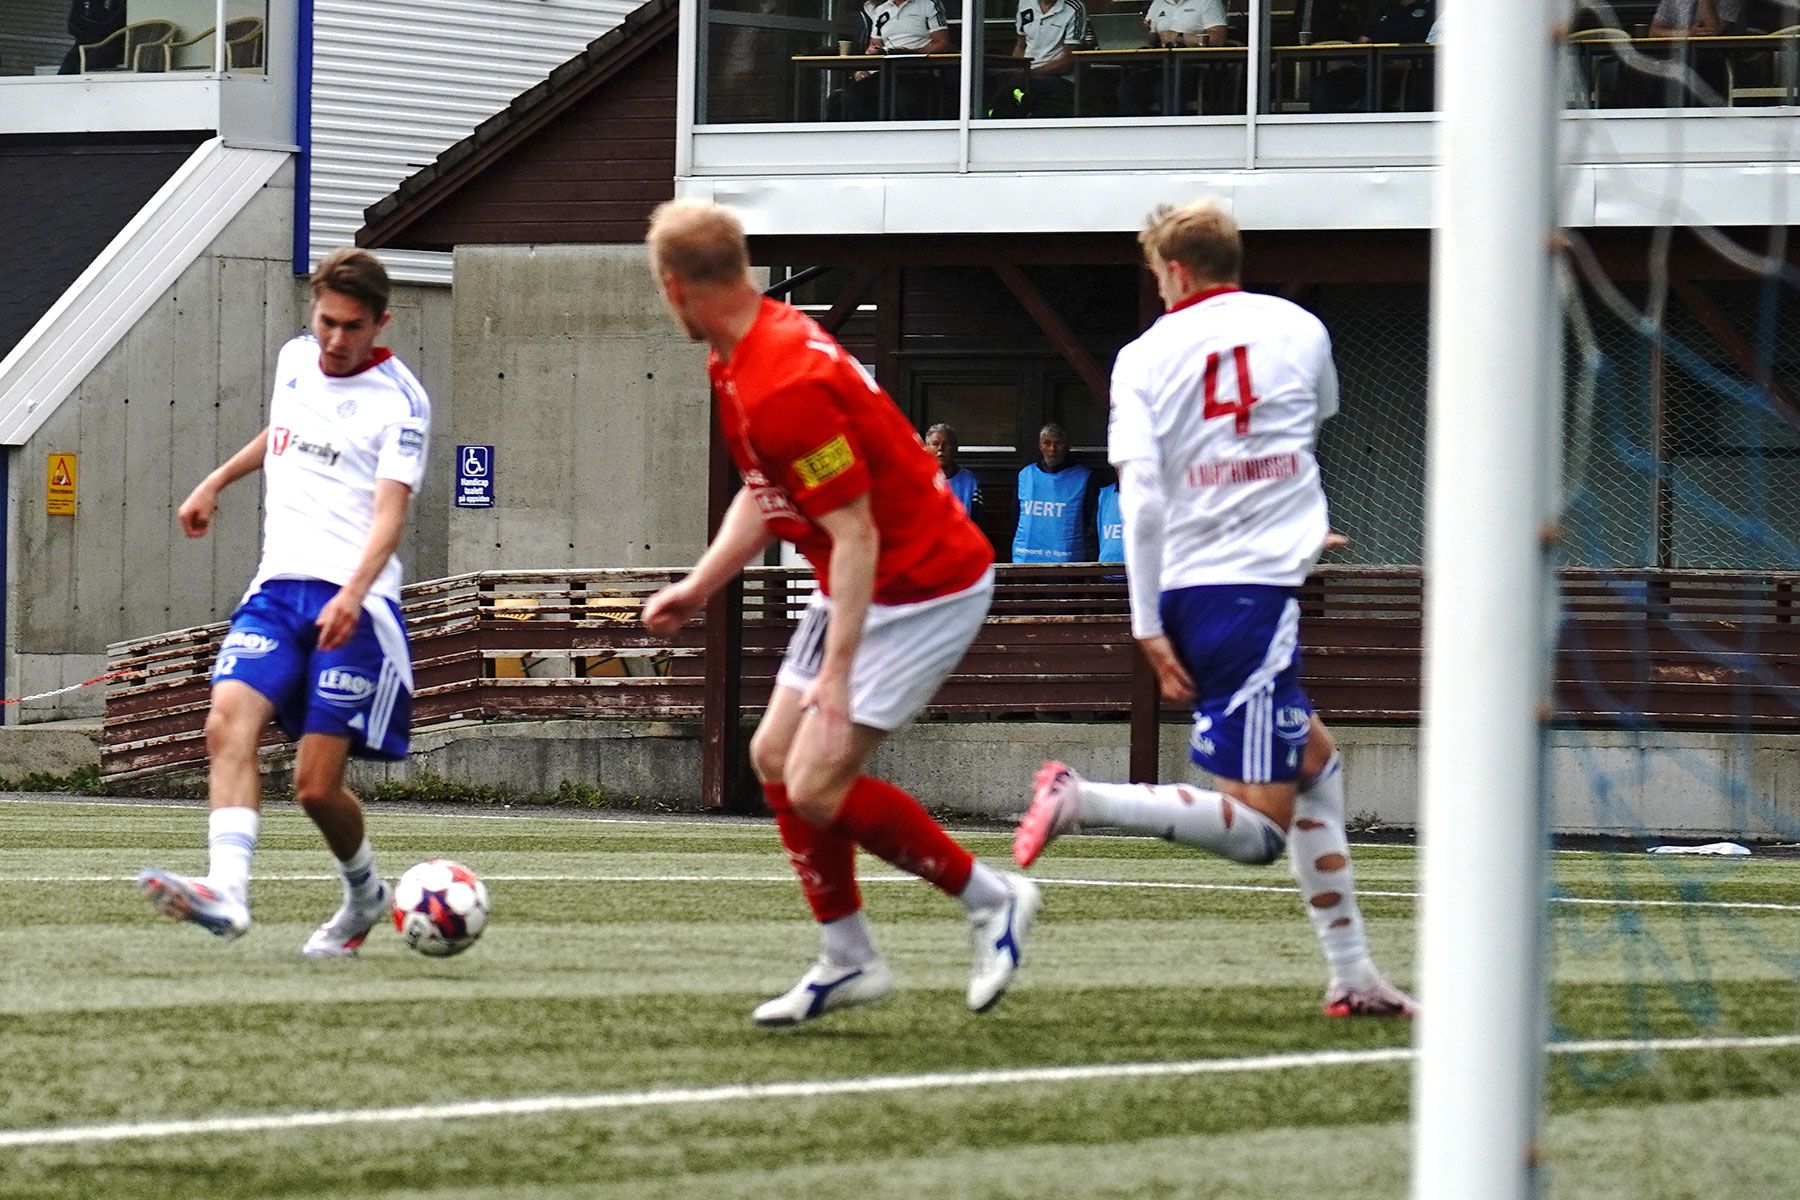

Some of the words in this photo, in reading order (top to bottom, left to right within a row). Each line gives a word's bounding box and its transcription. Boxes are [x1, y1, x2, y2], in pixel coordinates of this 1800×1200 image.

[1203, 344, 1261, 435] 4
[1022, 501, 1066, 517] VERT
[1102, 524, 1123, 539] VE
